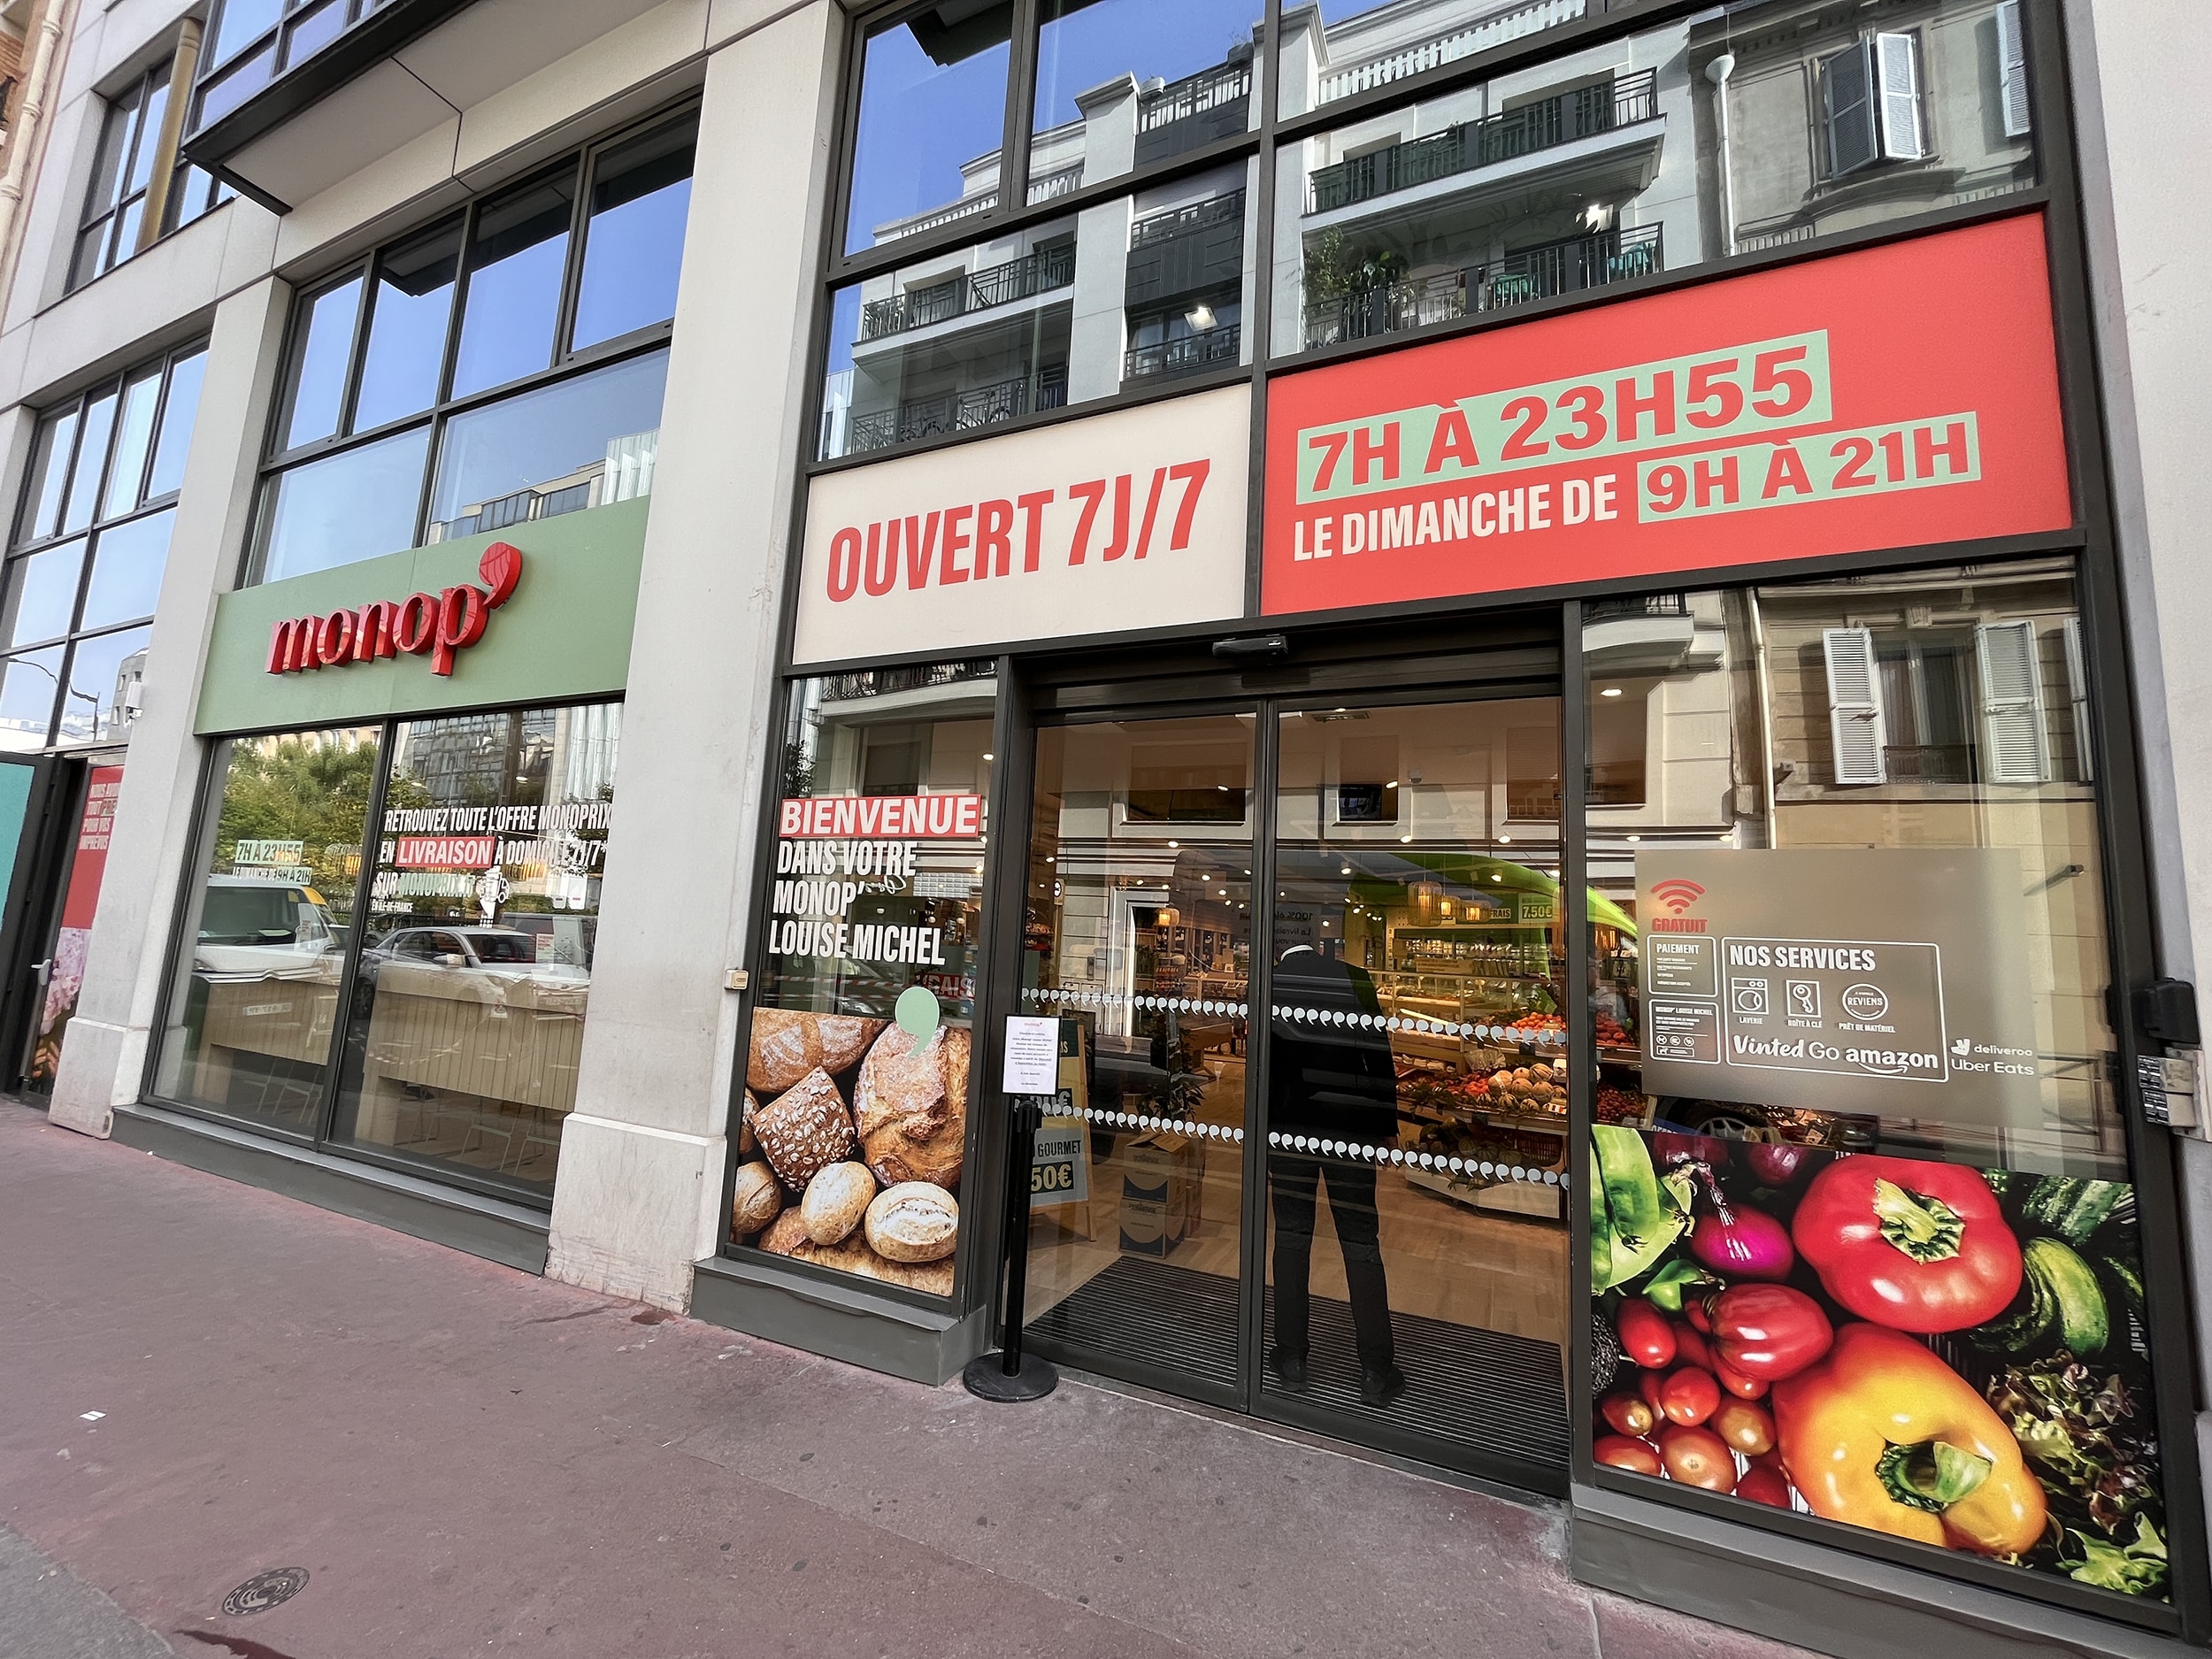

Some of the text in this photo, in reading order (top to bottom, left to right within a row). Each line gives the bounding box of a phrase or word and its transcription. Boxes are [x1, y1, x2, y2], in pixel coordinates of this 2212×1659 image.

[1309, 345, 1813, 493] 7H À 23H55
[1294, 421, 1969, 562] LE DIMANCHE DE 9H À 21H
[826, 458, 1210, 603] OUVERT 7J/7
[384, 803, 612, 832] RETROUVEZ TOUTE L'OFFRE MONOPRIX
[780, 796, 979, 835] BIENVENUE
[237, 843, 252, 861] 7H
[262, 843, 301, 863] 23H55
[379, 841, 396, 864] EN
[398, 840, 492, 865] LIVRAISON
[494, 836, 504, 864] À
[776, 841, 918, 877] DANS VOTRE
[296, 870, 311, 883] 21H
[375, 872, 398, 895] SUR
[772, 880, 865, 917] MONOP'
[1651, 918, 1708, 933] GRATUIT
[768, 920, 946, 965] LOUISE MICHEL
[1656, 943, 1700, 955] PAIEMENT
[1730, 945, 1876, 972] NOS SERVICES
[1847, 997, 1883, 1006] REVIENS
[1733, 1034, 1840, 1060] Vinted Go
[1845, 1048, 1939, 1071] amazon
[1974, 1044, 2033, 1057] deliveroo
[1951, 1058, 2035, 1076] Uber Eats
[1037, 1140, 1081, 1157] GOURMET
